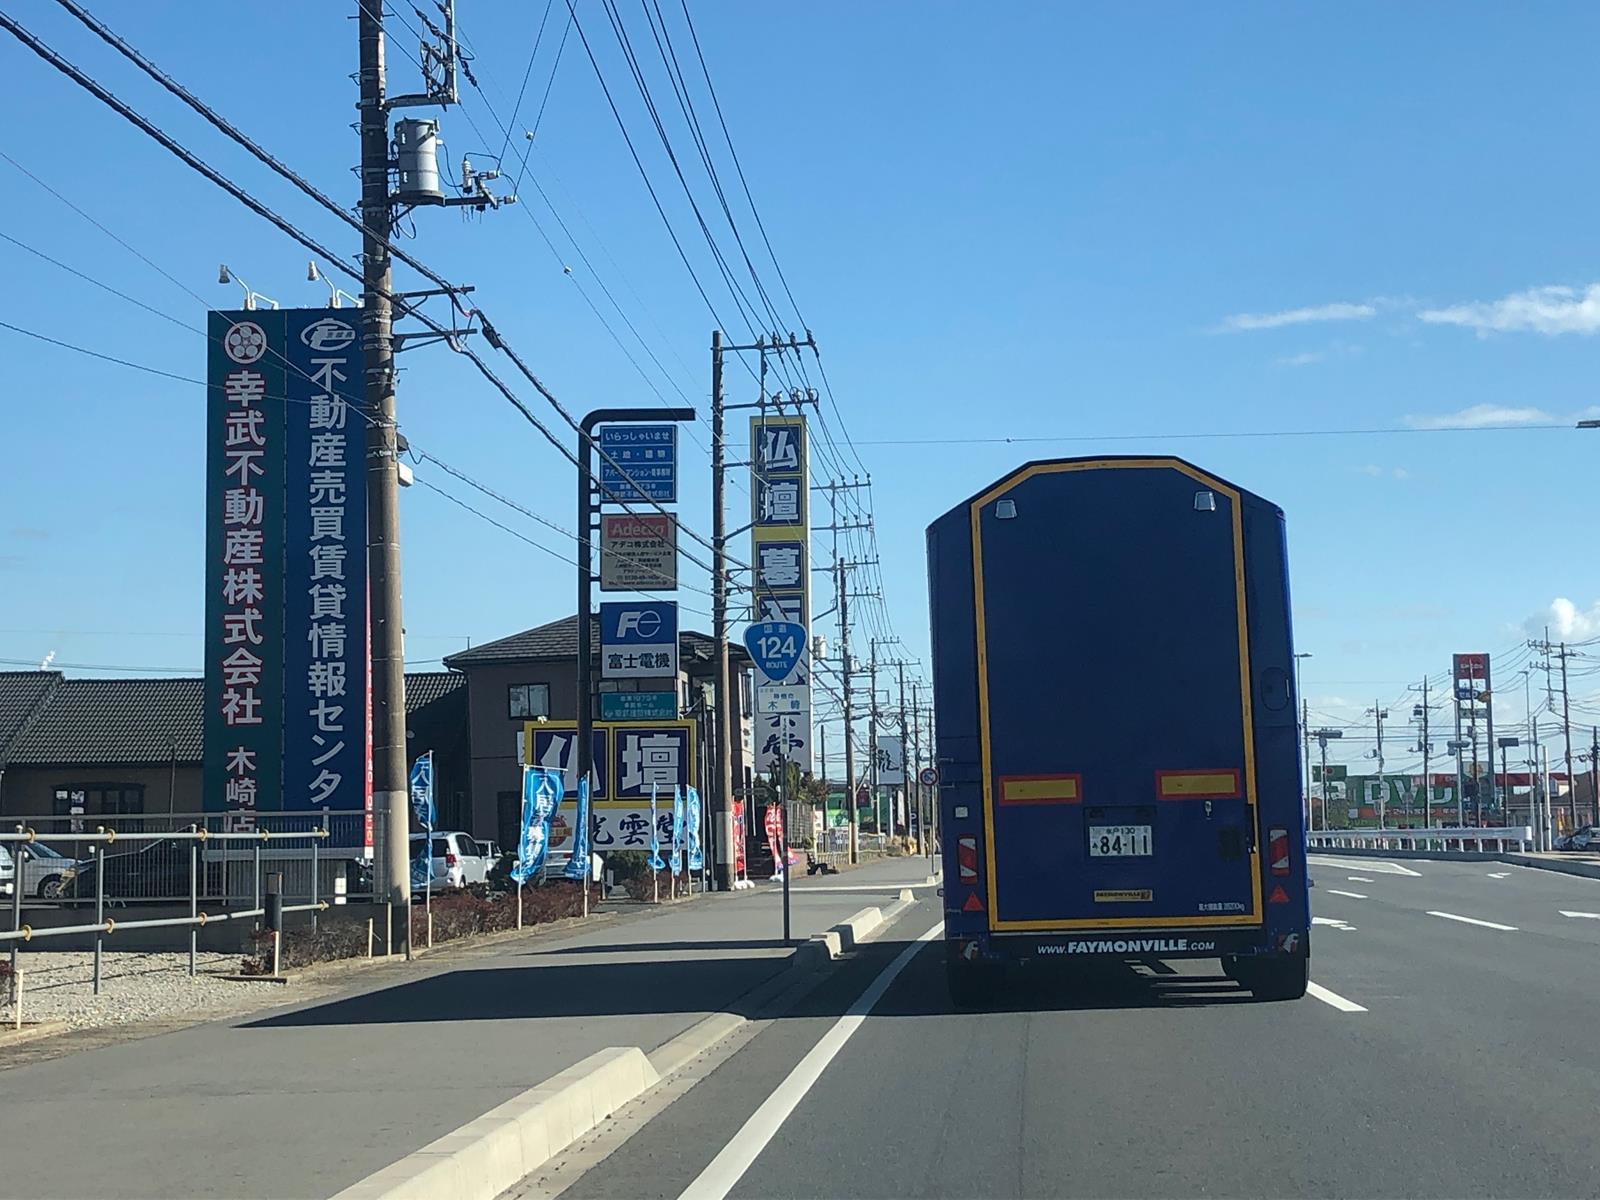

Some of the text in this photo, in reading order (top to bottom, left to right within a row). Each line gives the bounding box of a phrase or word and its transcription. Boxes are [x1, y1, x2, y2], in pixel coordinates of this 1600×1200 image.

[605, 431, 670, 441] いらっしゃいませ
[223, 369, 266, 833] 幸武不動産株式会社 木崎店
[308, 357, 347, 834] 不動産売買賃貸情報センター
[757, 635, 797, 659] 124
[608, 652, 670, 670] 富士電機
[766, 661, 788, 669] ROUTE
[541, 734, 681, 794] 仏壇
[1100, 835, 1148, 854] 84-11
